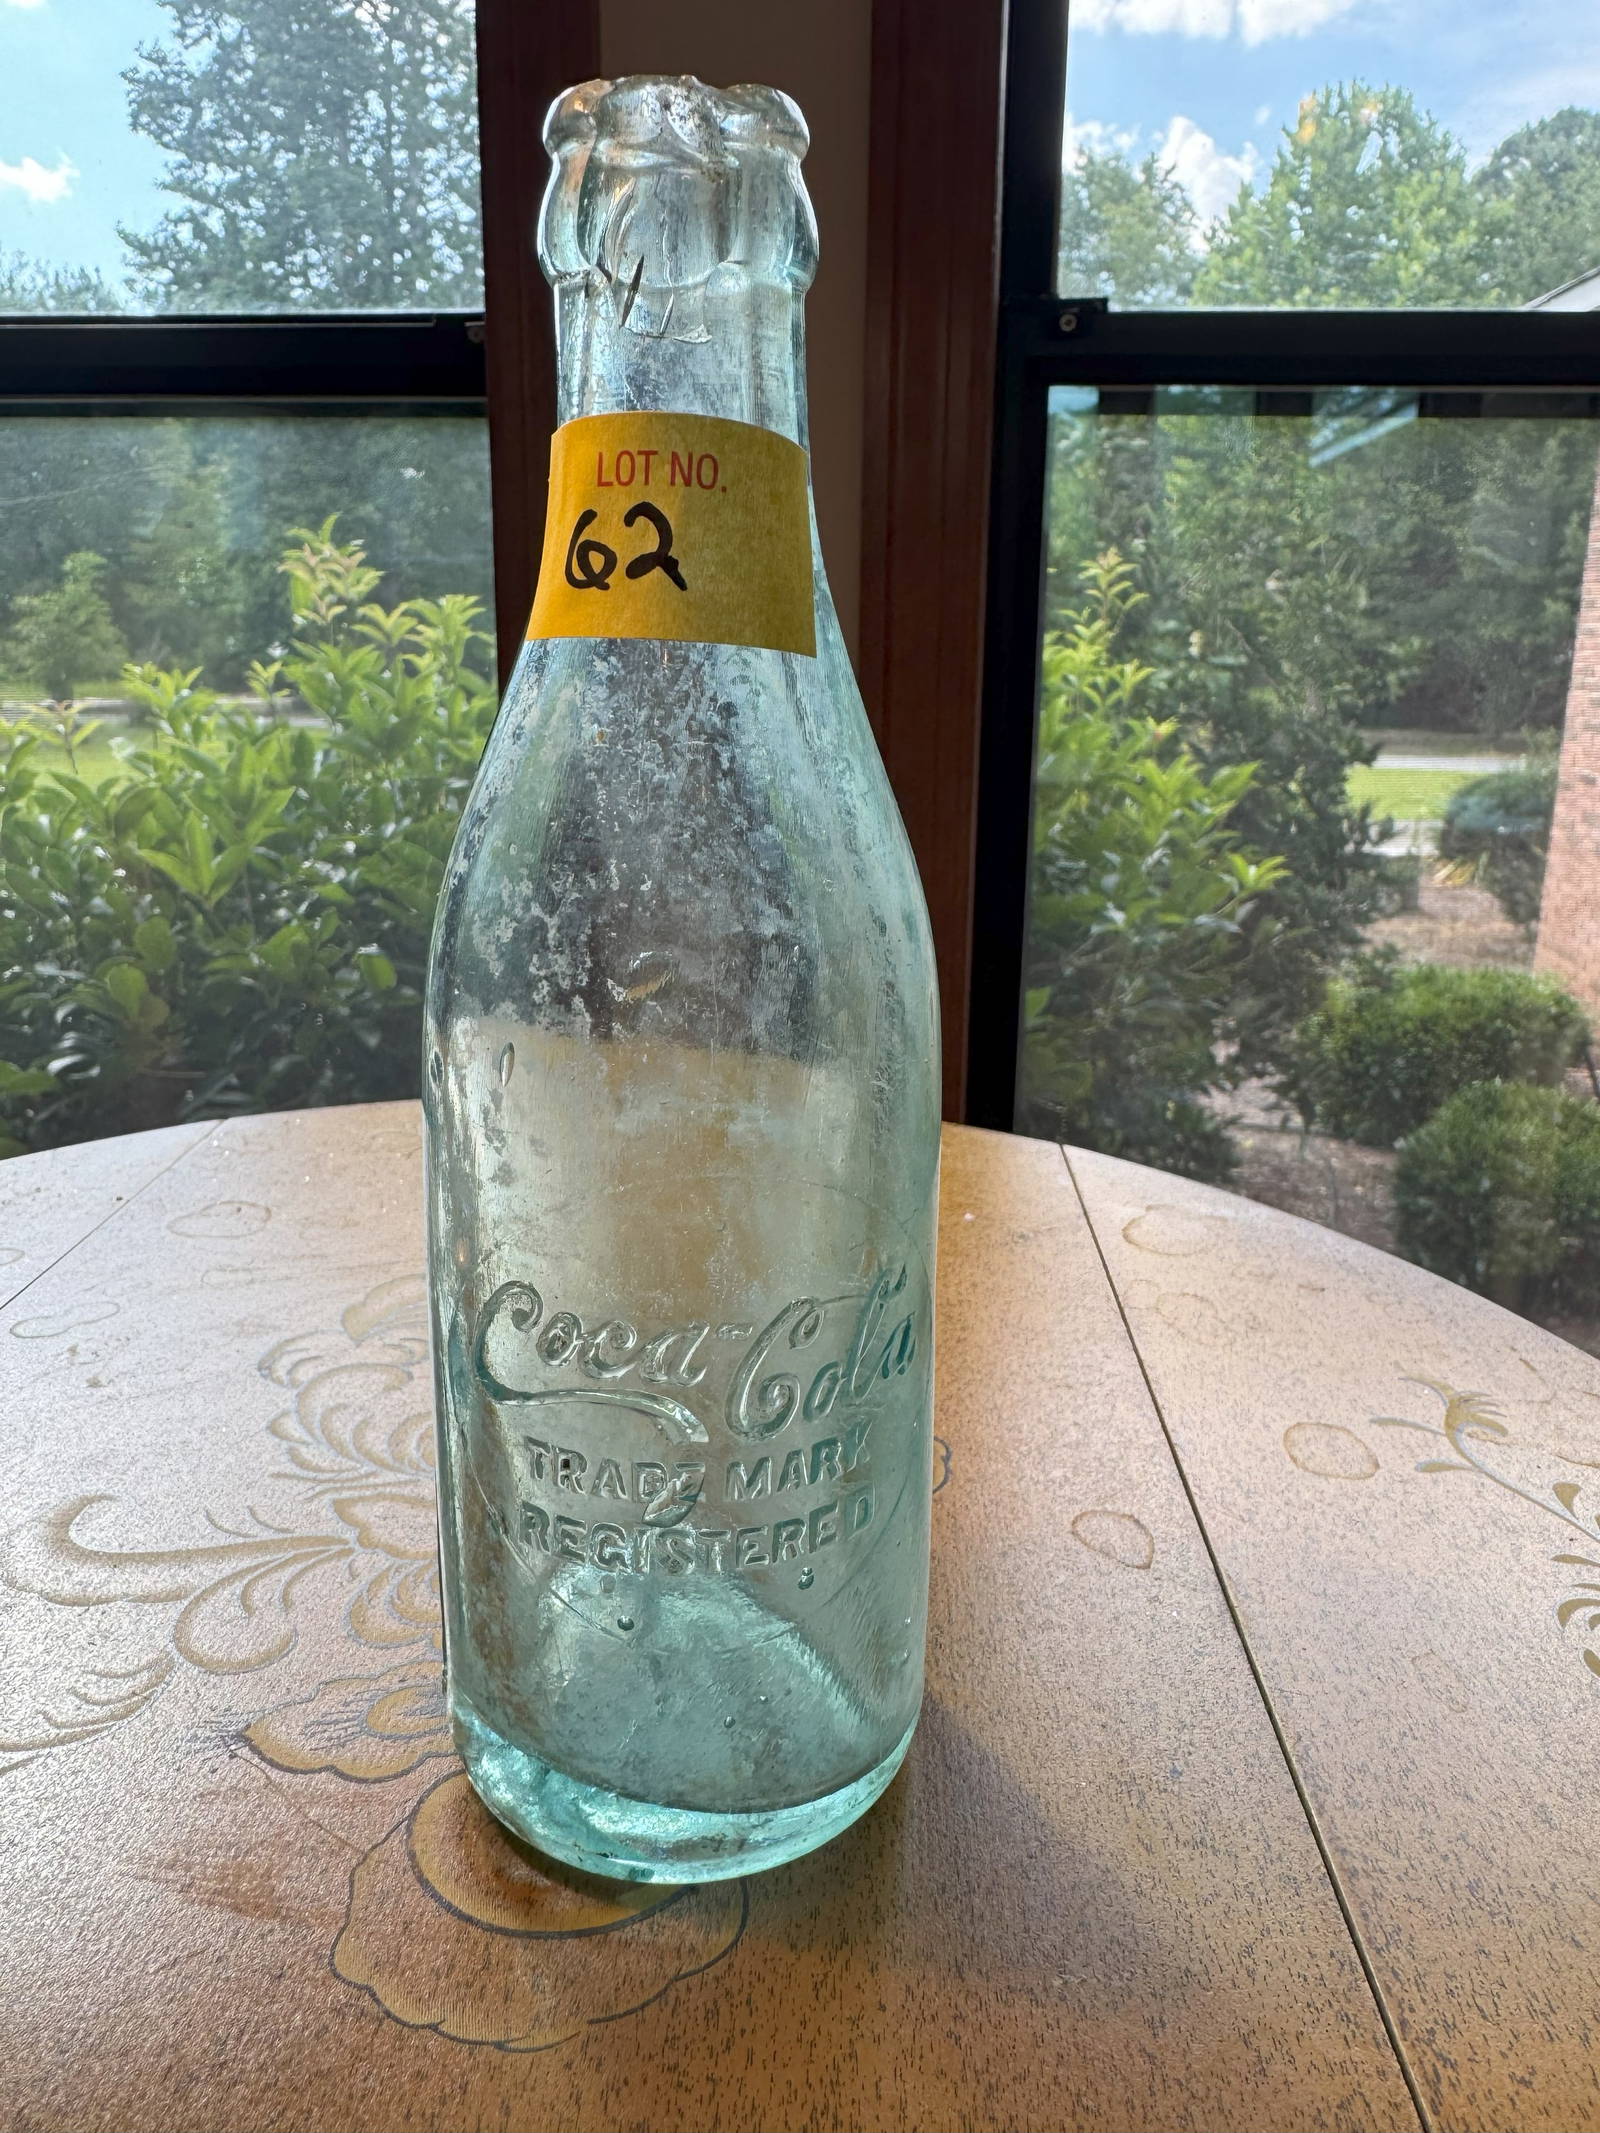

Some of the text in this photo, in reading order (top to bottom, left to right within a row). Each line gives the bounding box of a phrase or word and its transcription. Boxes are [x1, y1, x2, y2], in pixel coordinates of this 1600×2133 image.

[597, 450, 727, 493] LOT NO.
[565, 501, 688, 591] 62
[726, 1418, 874, 1502] MARK
[519, 1482, 877, 1575] REGISTERED
